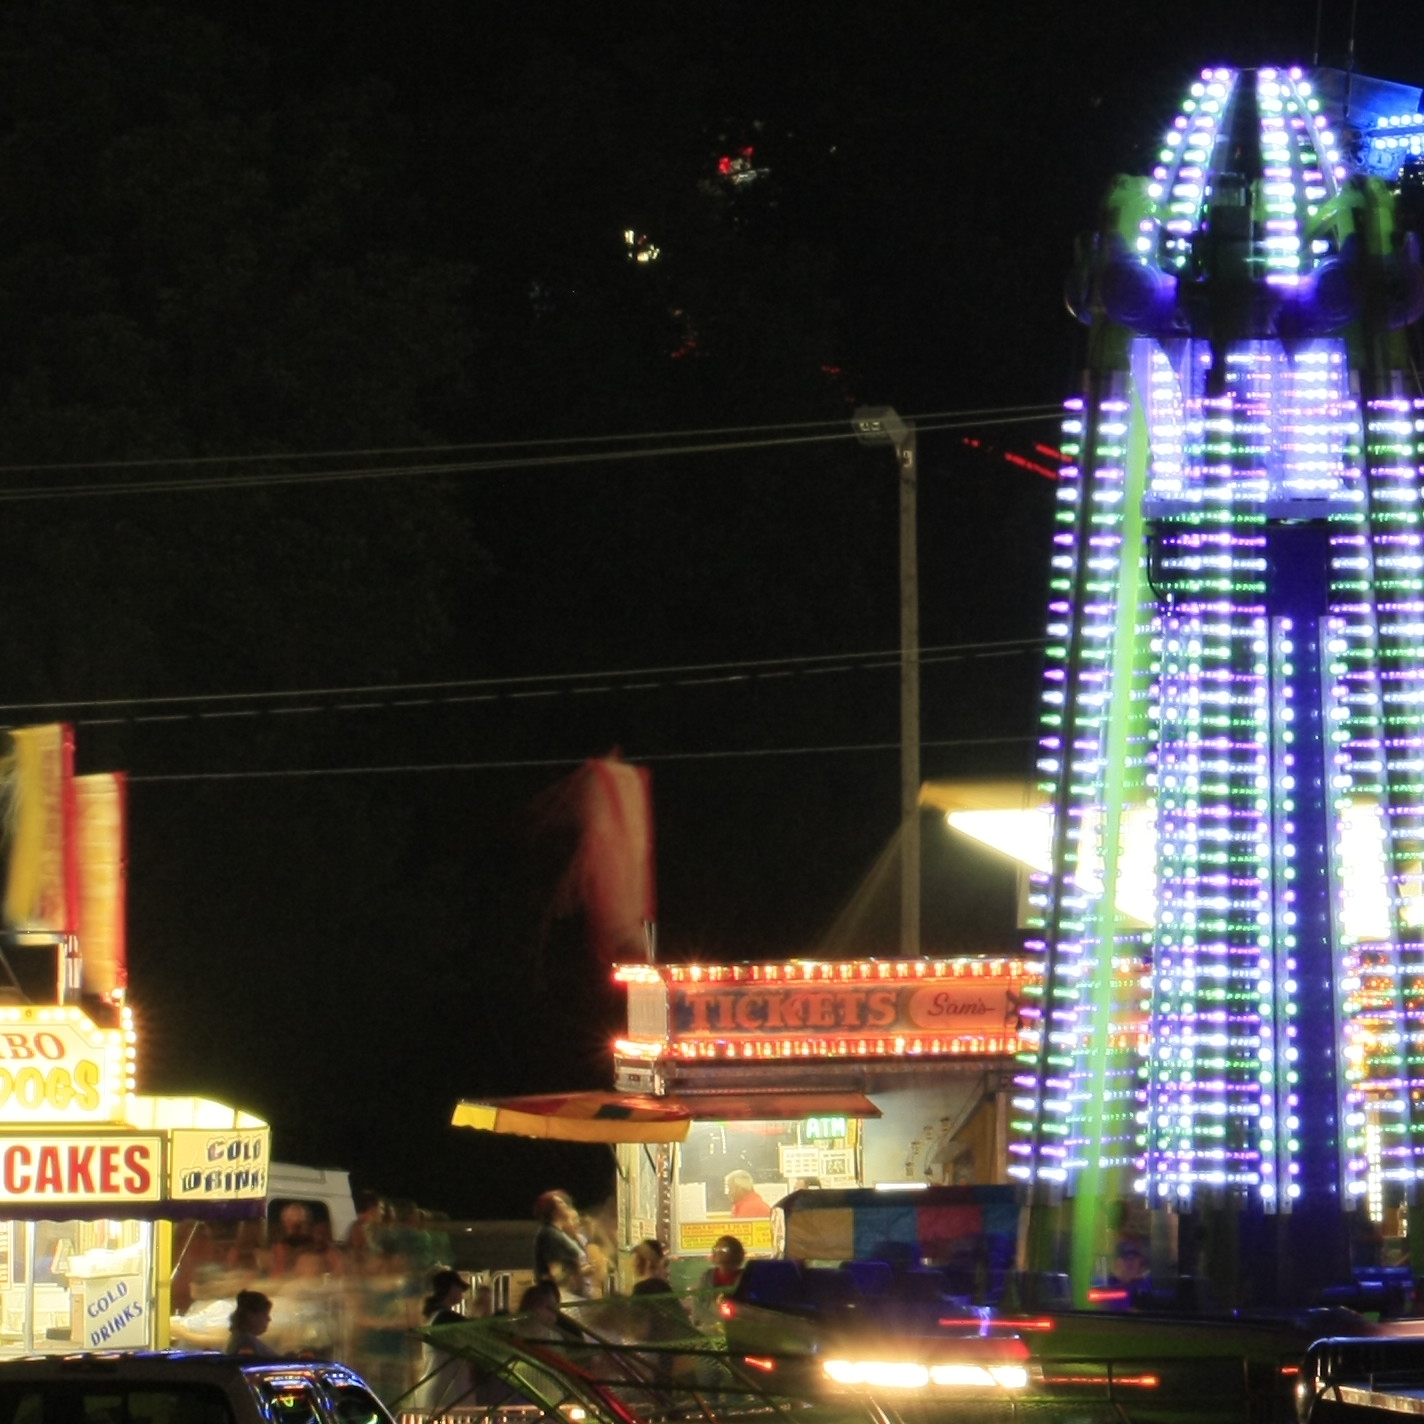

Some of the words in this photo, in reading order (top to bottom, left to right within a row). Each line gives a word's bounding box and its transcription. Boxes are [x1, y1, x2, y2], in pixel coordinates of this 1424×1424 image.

[685, 990, 896, 1030] TICKETS
[927, 992, 995, 1017] Sam's
[0, 1033, 65, 1060] BO
[806, 1117, 846, 1139] ATM
[3, 1145, 151, 1194] CAKES
[87, 1281, 128, 1318] COLD
[91, 1301, 144, 1346] DRINKS
